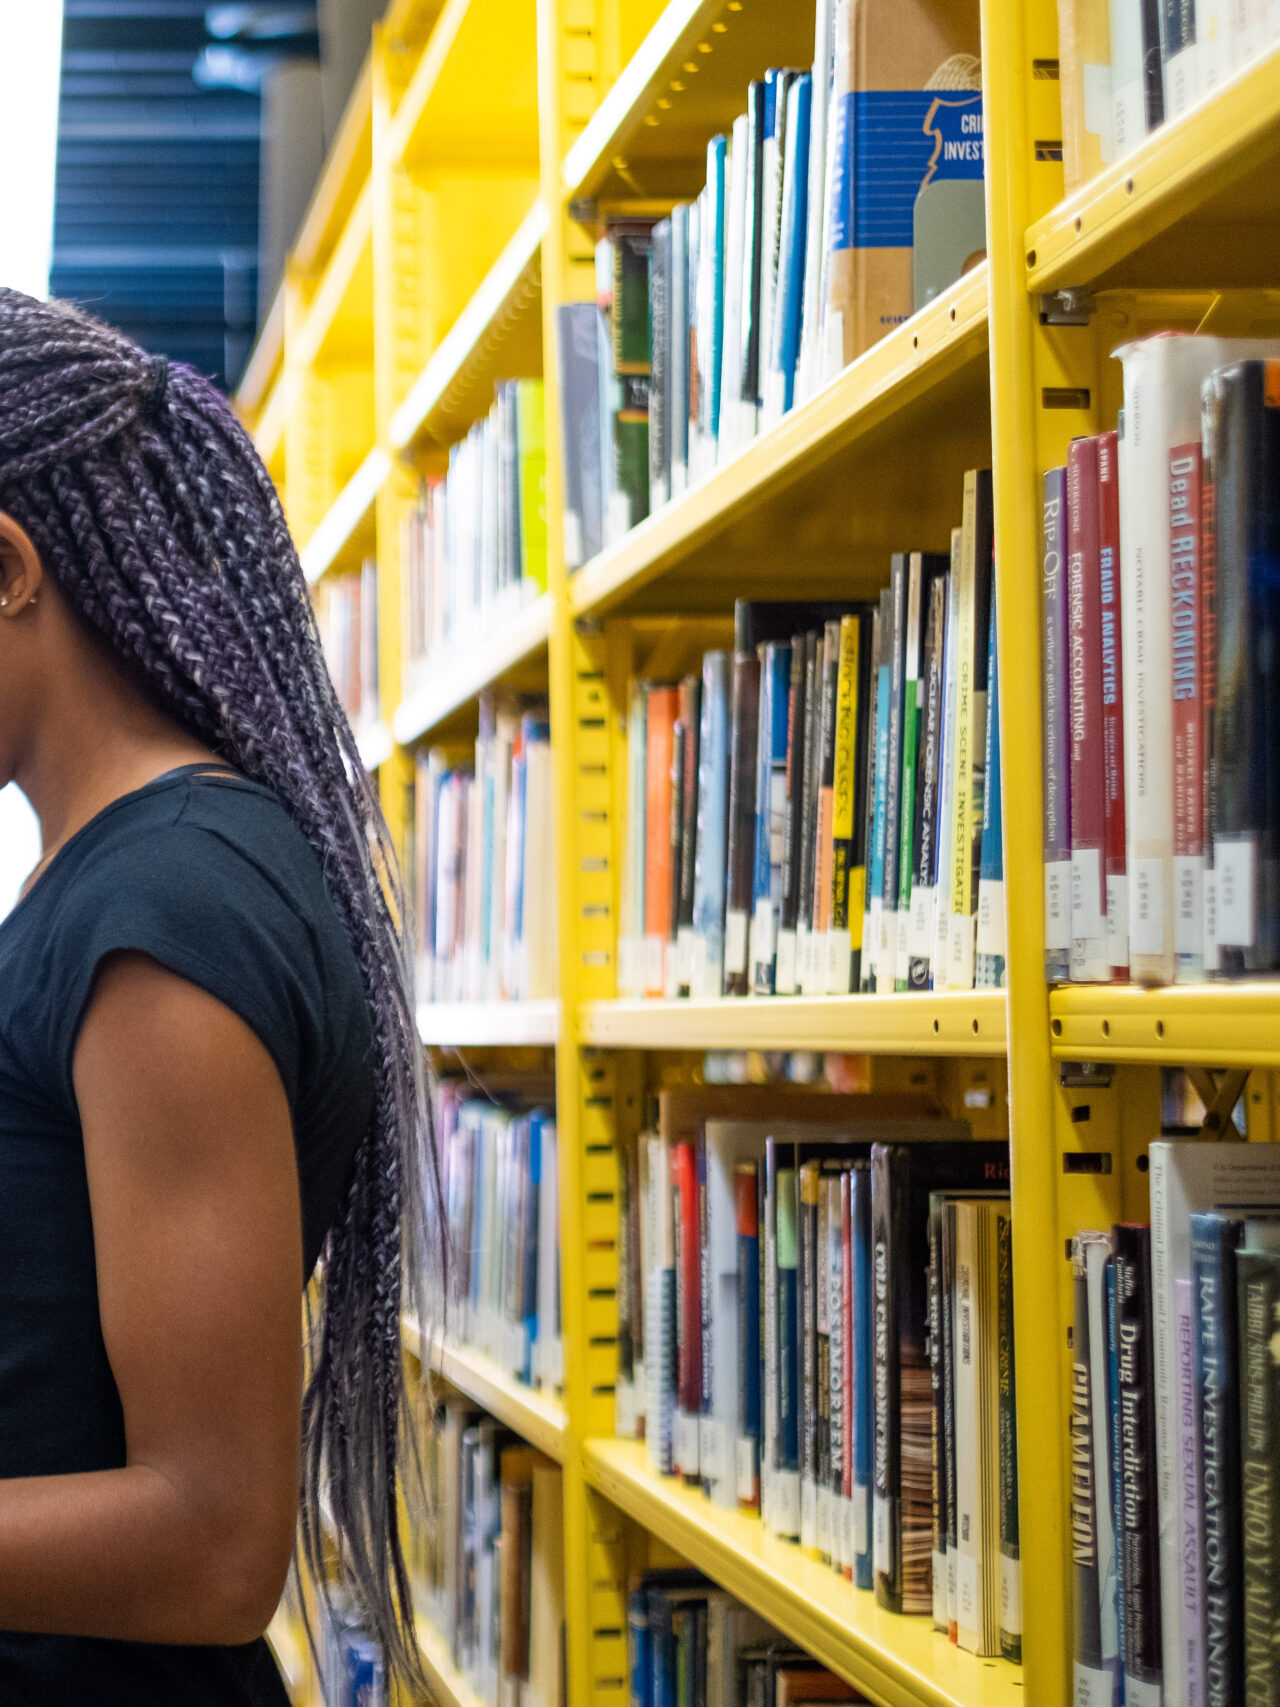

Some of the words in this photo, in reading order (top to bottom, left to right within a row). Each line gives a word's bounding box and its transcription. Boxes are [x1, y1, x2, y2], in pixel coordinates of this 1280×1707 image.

[1099, 448, 1110, 484] SPANN
[1170, 456, 1195, 529] Dead
[1071, 552, 1084, 631] FORENSIC
[1100, 547, 1115, 605] FRAUD
[1136, 620, 1145, 664] CRIME
[1171, 535, 1195, 702] RECKONING
[961, 661, 969, 720] CRIME
[1045, 671, 1057, 707] guide
[1072, 636, 1086, 742] ACCOUNTING
[1101, 611, 1117, 705] ANALYTICS
[958, 725, 968, 782] SCENE
[1046, 725, 1057, 764] crimes
[1136, 672, 1146, 798] INVESTIGATIONS
[1185, 722, 1197, 781] MICHAEL
[922, 735, 935, 819] FORENSIC
[1045, 782, 1058, 842] deception
[1176, 764, 1186, 818] MARION
[875, 1242, 887, 1300] COLD
[875, 1304, 887, 1361] CASE
[1200, 1276, 1218, 1346] RAPE
[831, 1274, 842, 1472] POSTMORTEM
[999, 1335, 1010, 1397] CRIME
[1119, 1322, 1139, 1384] Drug
[1179, 1314, 1193, 1427] REPORTING
[876, 1365, 888, 1489] HOMICIDES
[1072, 1361, 1094, 1566] CHAMELEON
[1121, 1388, 1141, 1529] Interdiction
[1182, 1434, 1195, 1510] SEXUAL
[1202, 1355, 1224, 1586] INVESTIGATION
[1244, 1460, 1272, 1575] UNHOLY
[1184, 1521, 1198, 1615] ASSAULT
